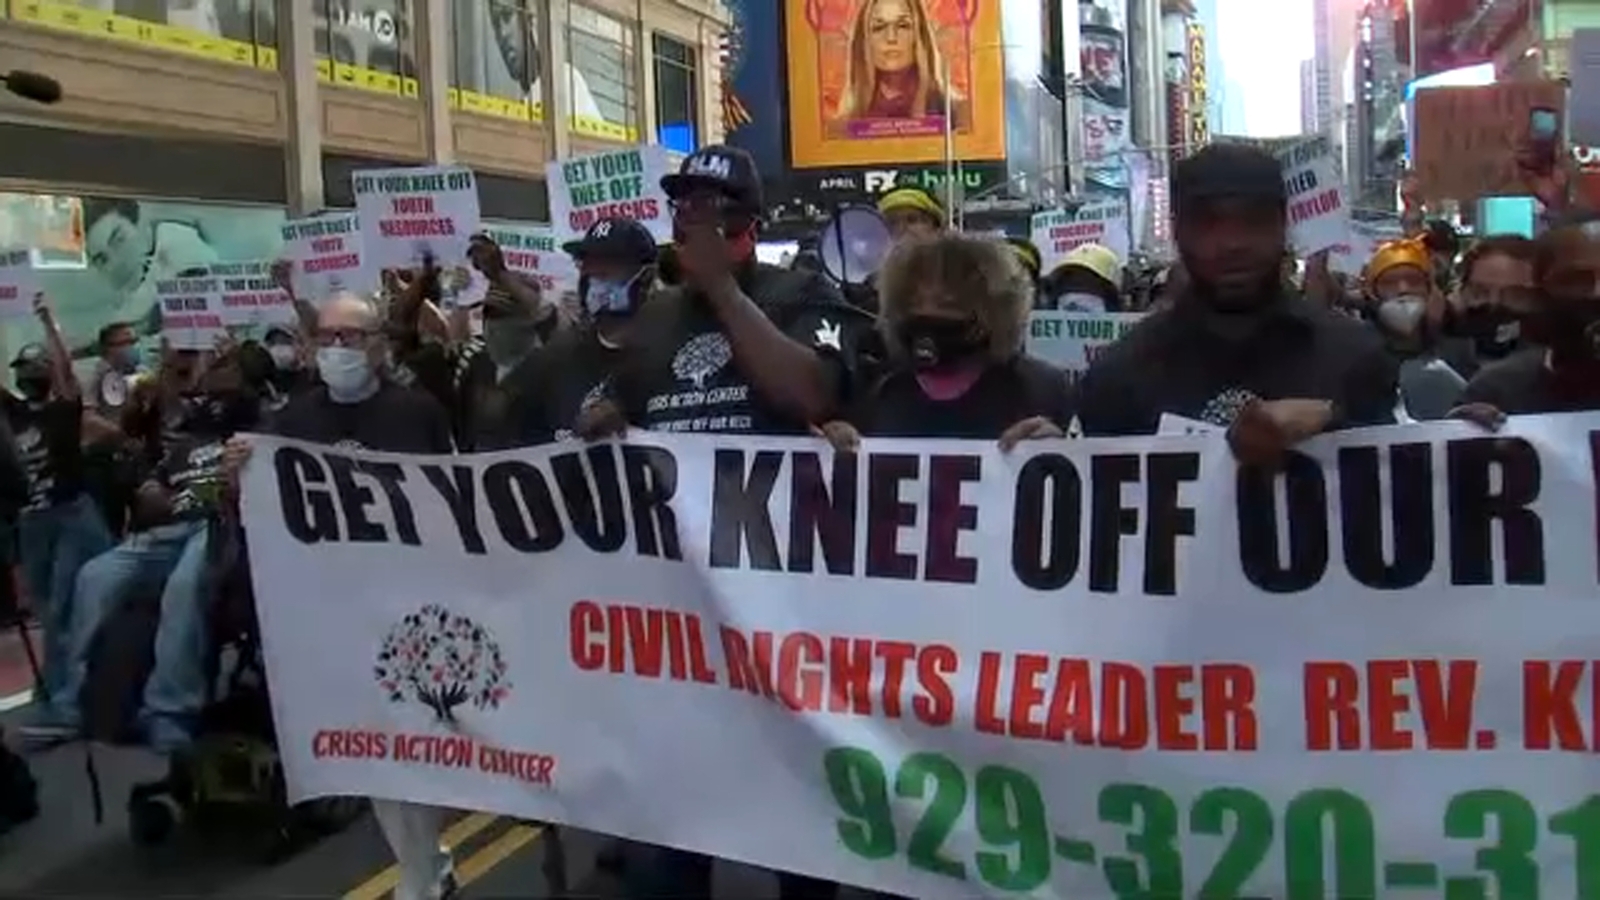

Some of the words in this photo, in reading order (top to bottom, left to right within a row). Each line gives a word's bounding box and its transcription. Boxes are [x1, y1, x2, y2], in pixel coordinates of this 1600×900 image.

[562, 158, 588, 184] GET
[590, 149, 643, 179] YOUR
[376, 175, 408, 194] YOUR
[447, 171, 471, 190] OFF
[570, 182, 607, 208] KNEE
[609, 175, 642, 200] OFF
[819, 178, 856, 190] APRIL
[864, 170, 900, 192] FX
[391, 196, 435, 215] YOUTH
[507, 251, 539, 269] OUTH
[1032, 319, 1062, 338] GET
[1066, 319, 1114, 340] YOUR
[273, 445, 424, 547] GET
[420, 443, 684, 563] YOUR
[709, 448, 982, 585] KNEE
[1010, 450, 1201, 596] OFF
[1235, 435, 1547, 594] OUR
[569, 600, 717, 686] CIVIL
[719, 624, 957, 728] RIGHTS
[975, 650, 1259, 752] LEADER
[1304, 659, 1496, 751] REV.
[1522, 659, 1600, 752] K
[312, 730, 388, 761] CRISIS
[392, 734, 474, 769] ACTION
[478, 745, 556, 785] CENTER
